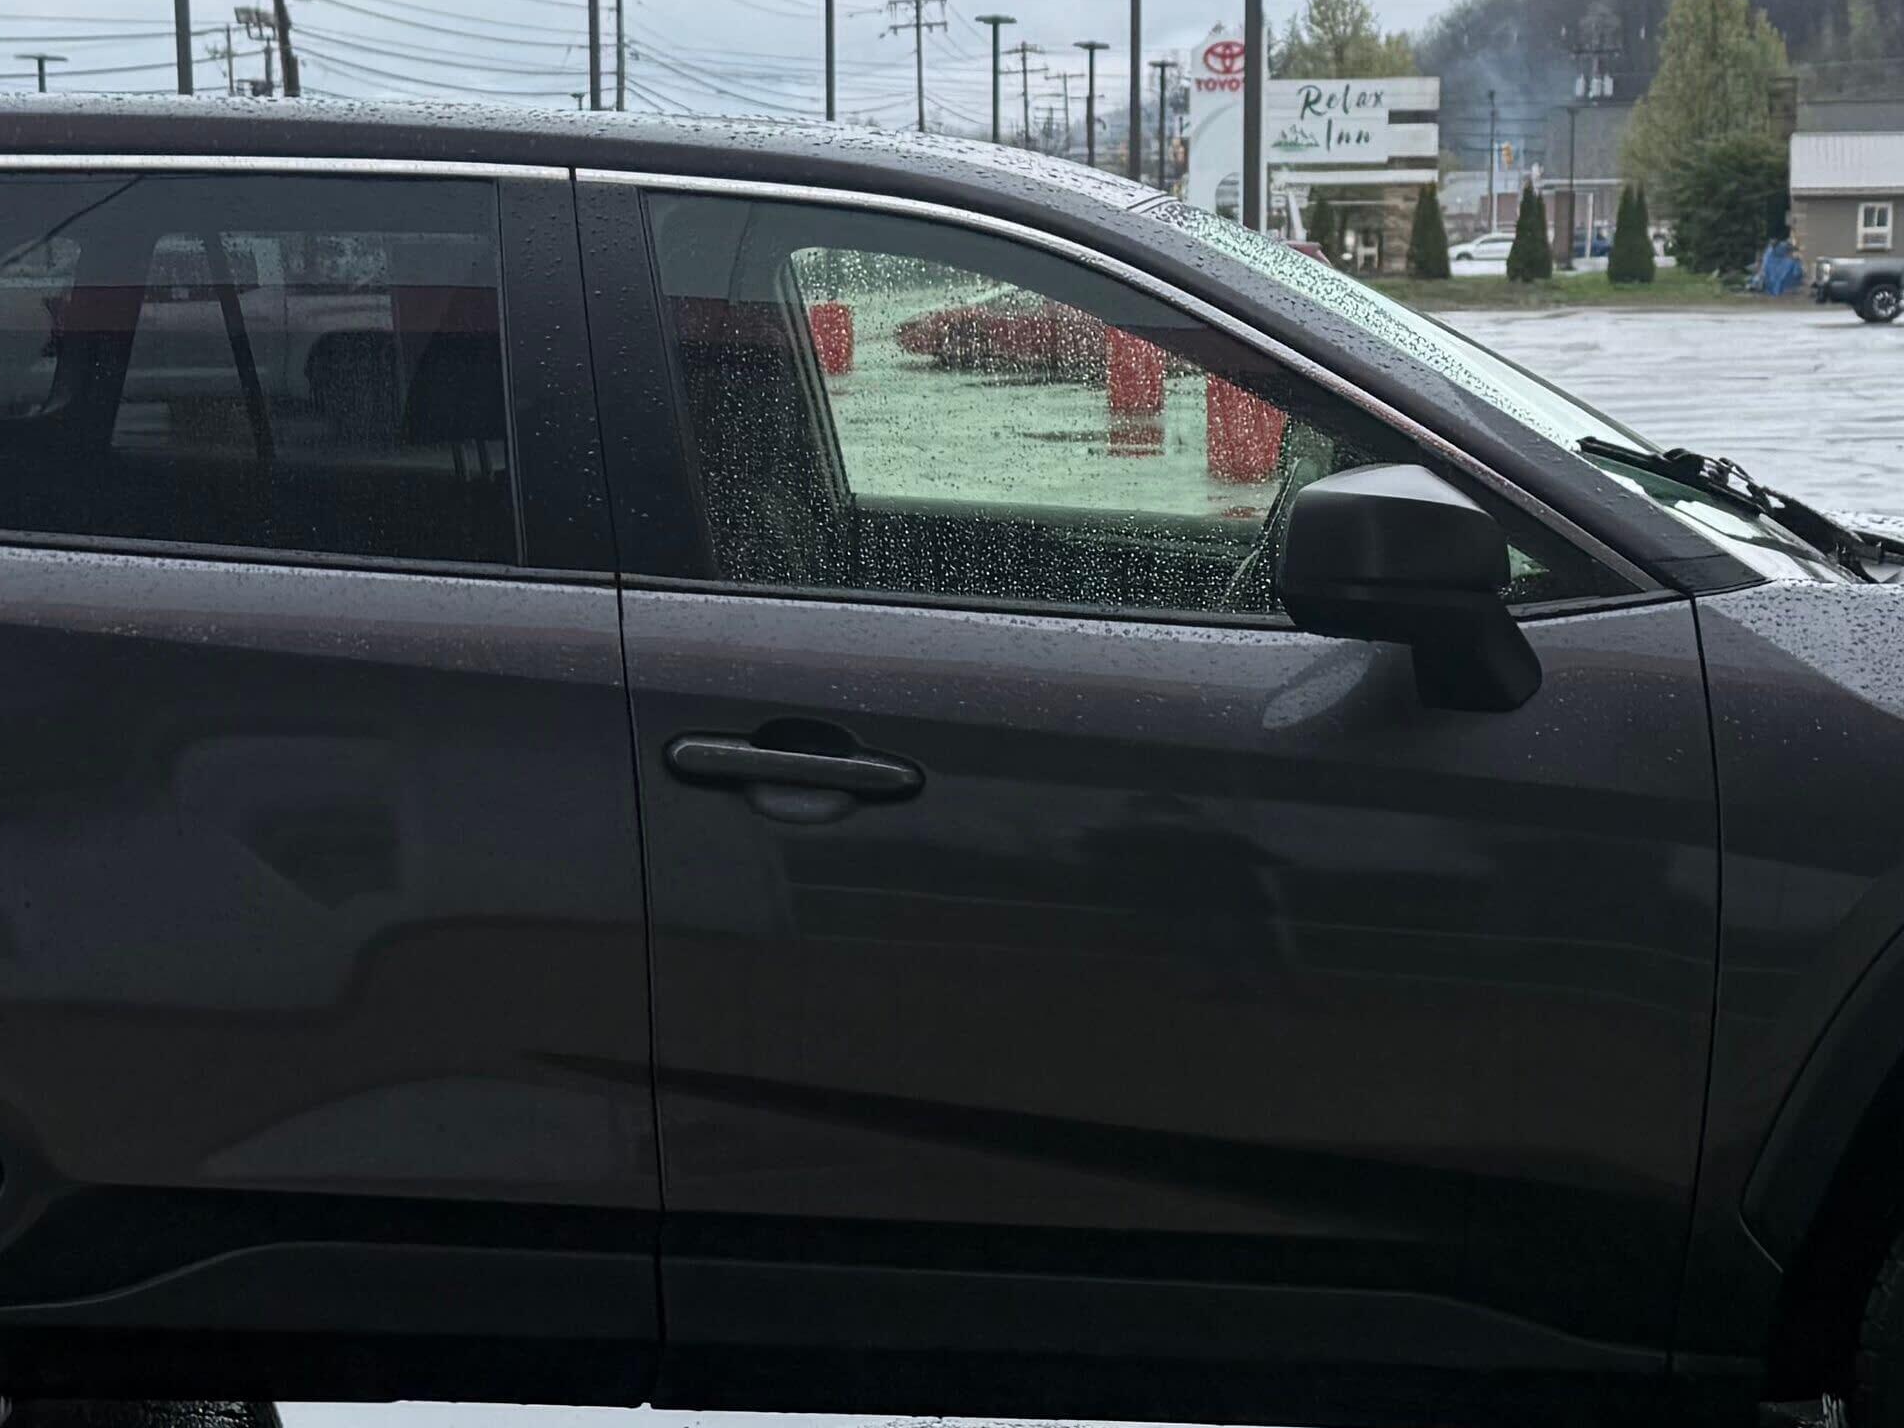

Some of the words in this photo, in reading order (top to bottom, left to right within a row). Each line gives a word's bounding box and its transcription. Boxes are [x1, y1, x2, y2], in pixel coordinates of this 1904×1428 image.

[1195, 78, 1245, 92] TOYO
[1298, 83, 1384, 120] Relax
[1326, 118, 1371, 151] Inn
